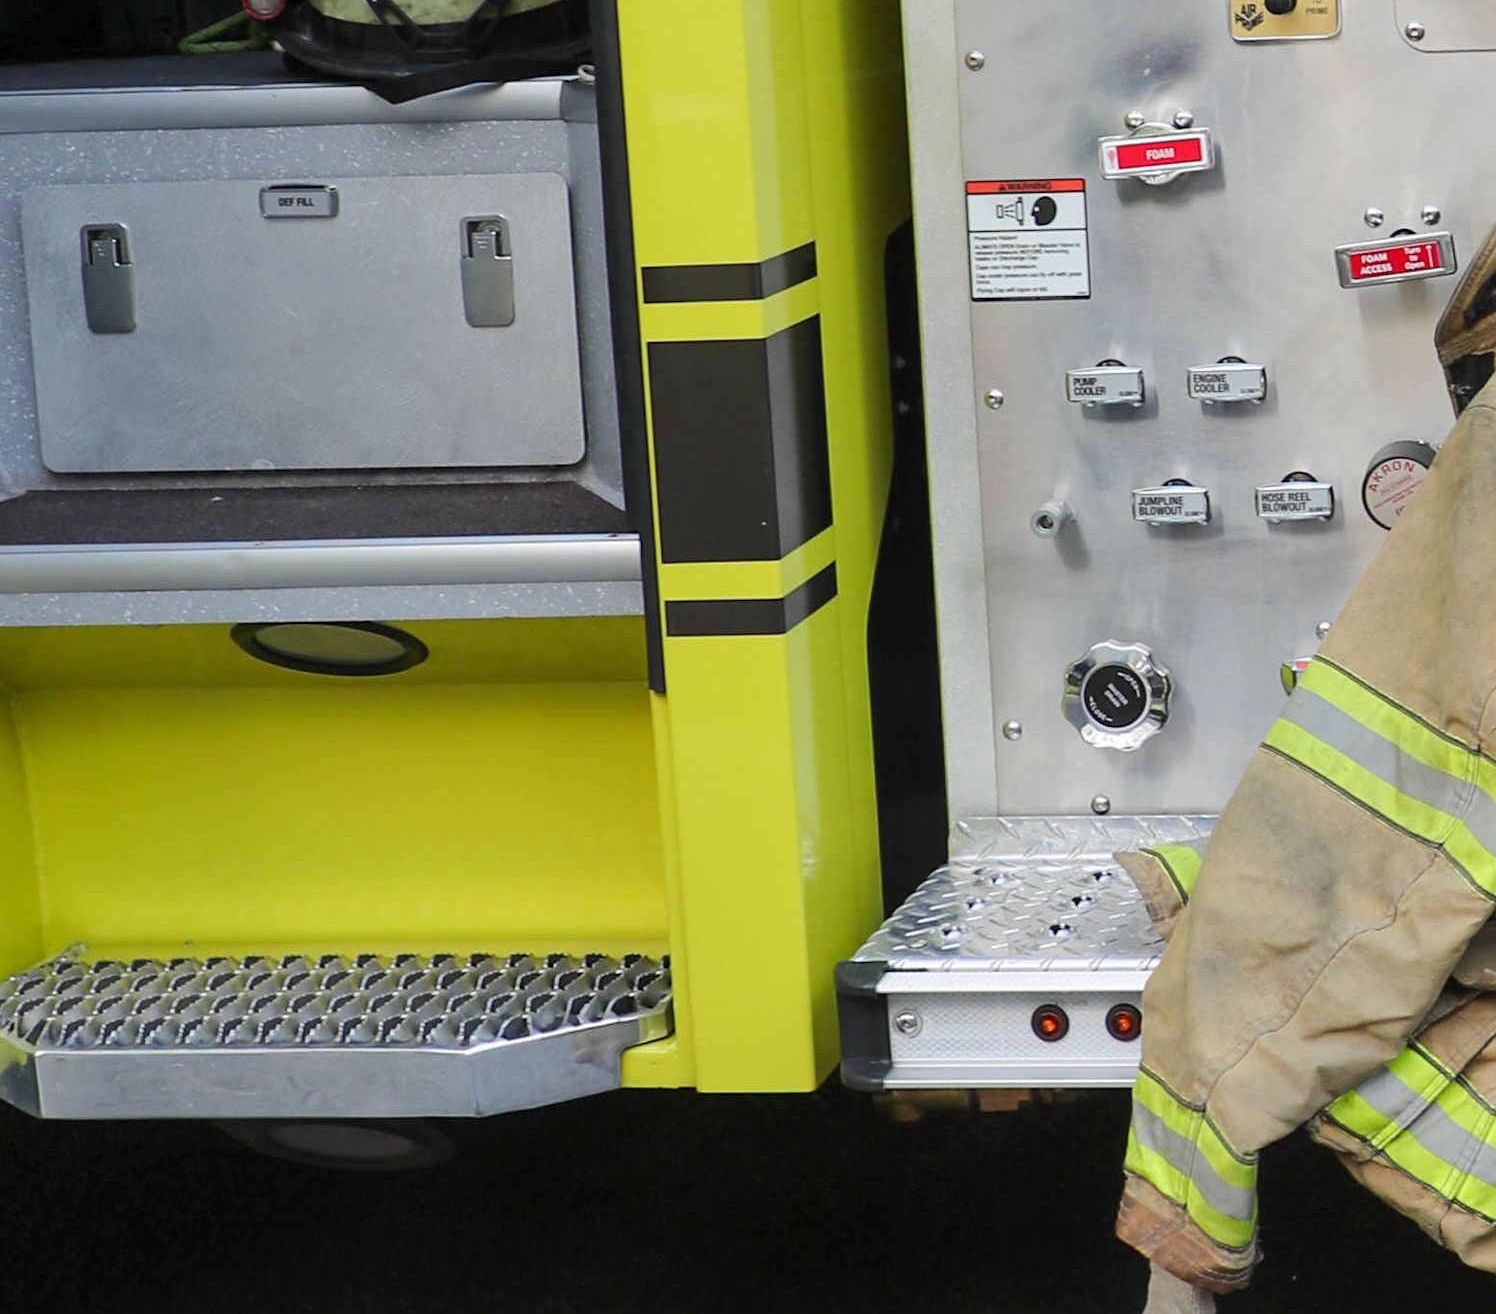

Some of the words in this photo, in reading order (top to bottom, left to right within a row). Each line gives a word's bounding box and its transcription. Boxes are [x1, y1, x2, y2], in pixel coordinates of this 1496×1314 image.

[1146, 147, 1176, 161] FOAM
[278, 197, 294, 207] DEF
[297, 197, 315, 207] FILL
[1404, 247, 1422, 255] Turn
[1360, 253, 1388, 263] FOAM
[1360, 263, 1393, 275] ACCESS
[1404, 261, 1425, 271] Open
[1073, 377, 1097, 386] PUMP
[1193, 374, 1228, 383] ENGINE
[1074, 387, 1106, 396] COOLER
[1194, 383, 1230, 393] COOLER
[1368, 460, 1415, 493] AKRON
[1138, 496, 1184, 506] JUMPLINE
[1262, 493, 1285, 501] HOSE
[1288, 491, 1312, 501] REEL
[1139, 506, 1182, 515] BLOWOUT
[1262, 501, 1306, 511] BLOWOUT
